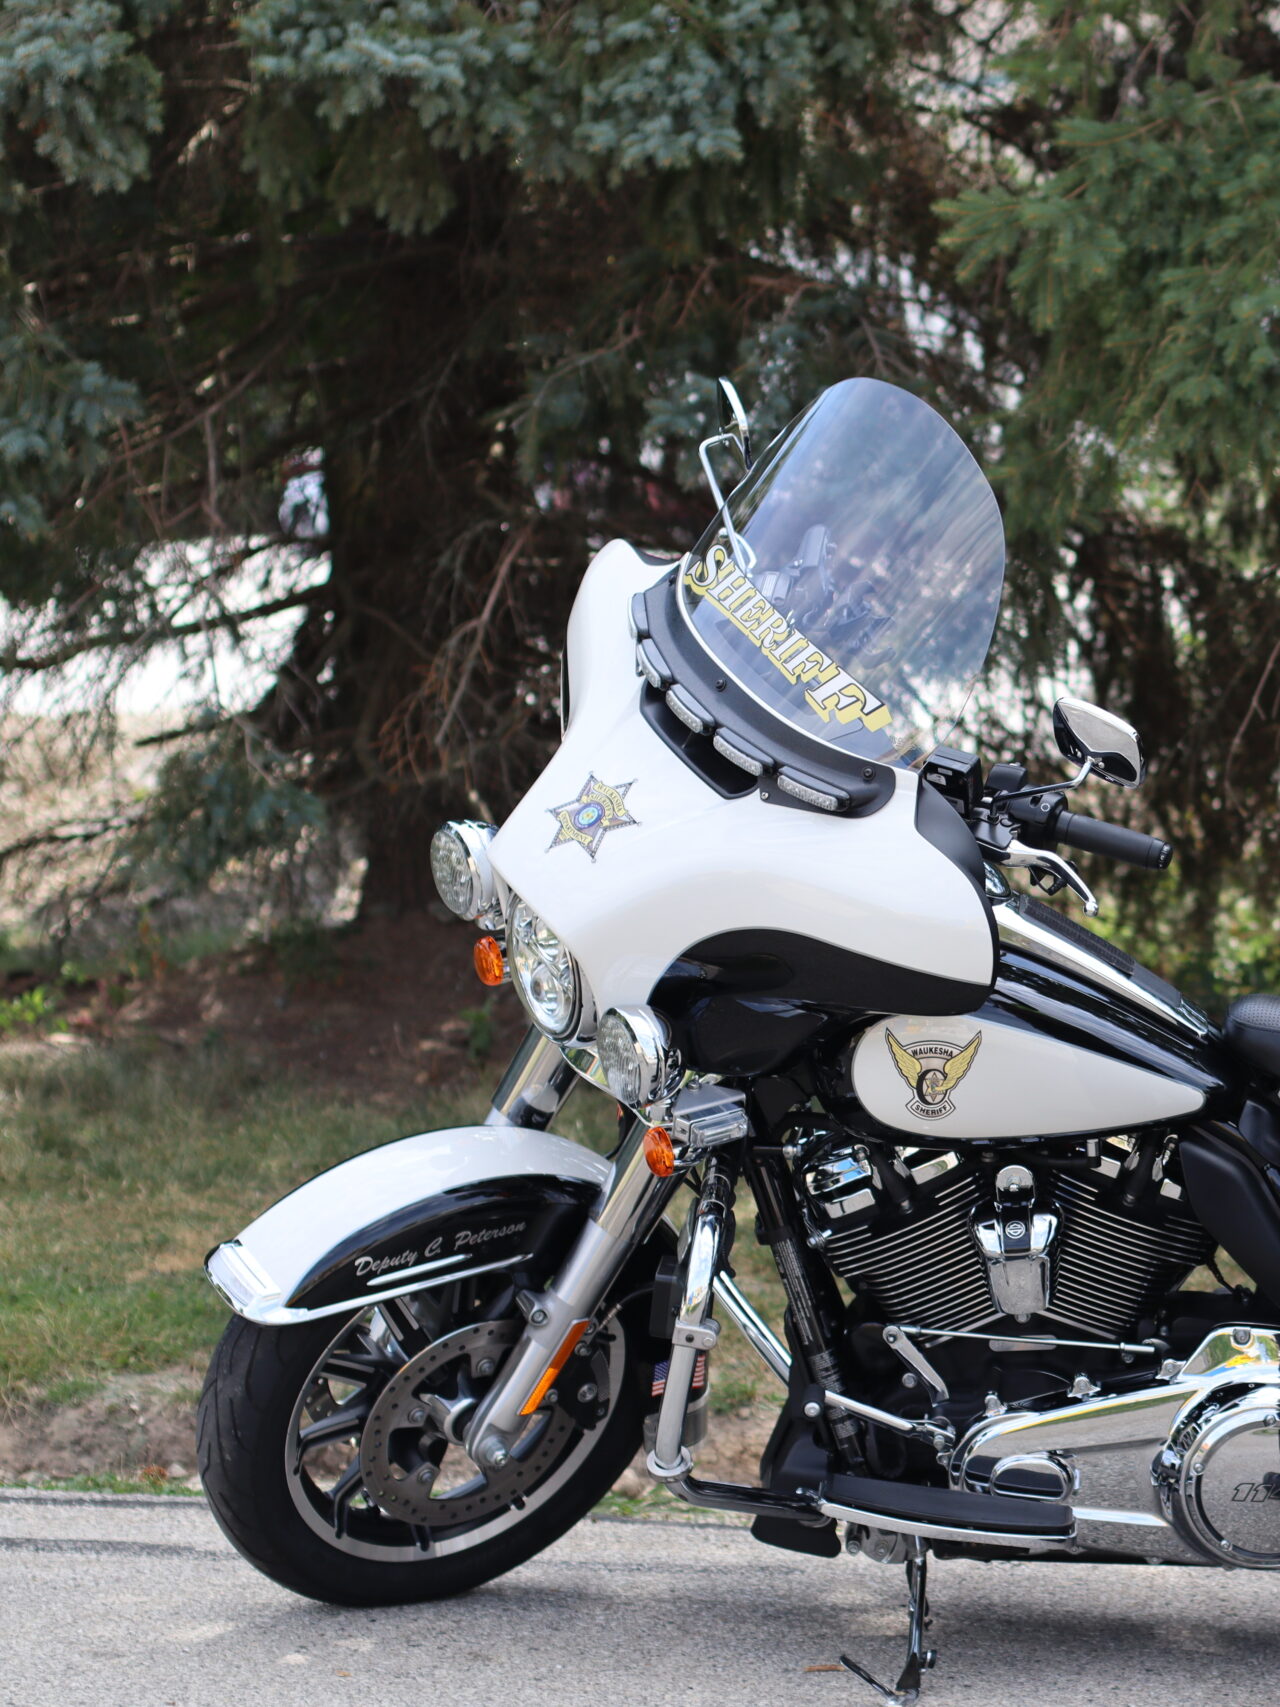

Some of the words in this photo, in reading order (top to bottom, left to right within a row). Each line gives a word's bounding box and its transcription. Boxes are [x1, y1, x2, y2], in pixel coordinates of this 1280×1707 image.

[684, 544, 892, 732] SHERIFF
[911, 1047, 954, 1058] WAUKESHA
[915, 1105, 948, 1116] SHERIFF
[354, 1250, 418, 1277] Deputy
[454, 1221, 527, 1250] Peterson
